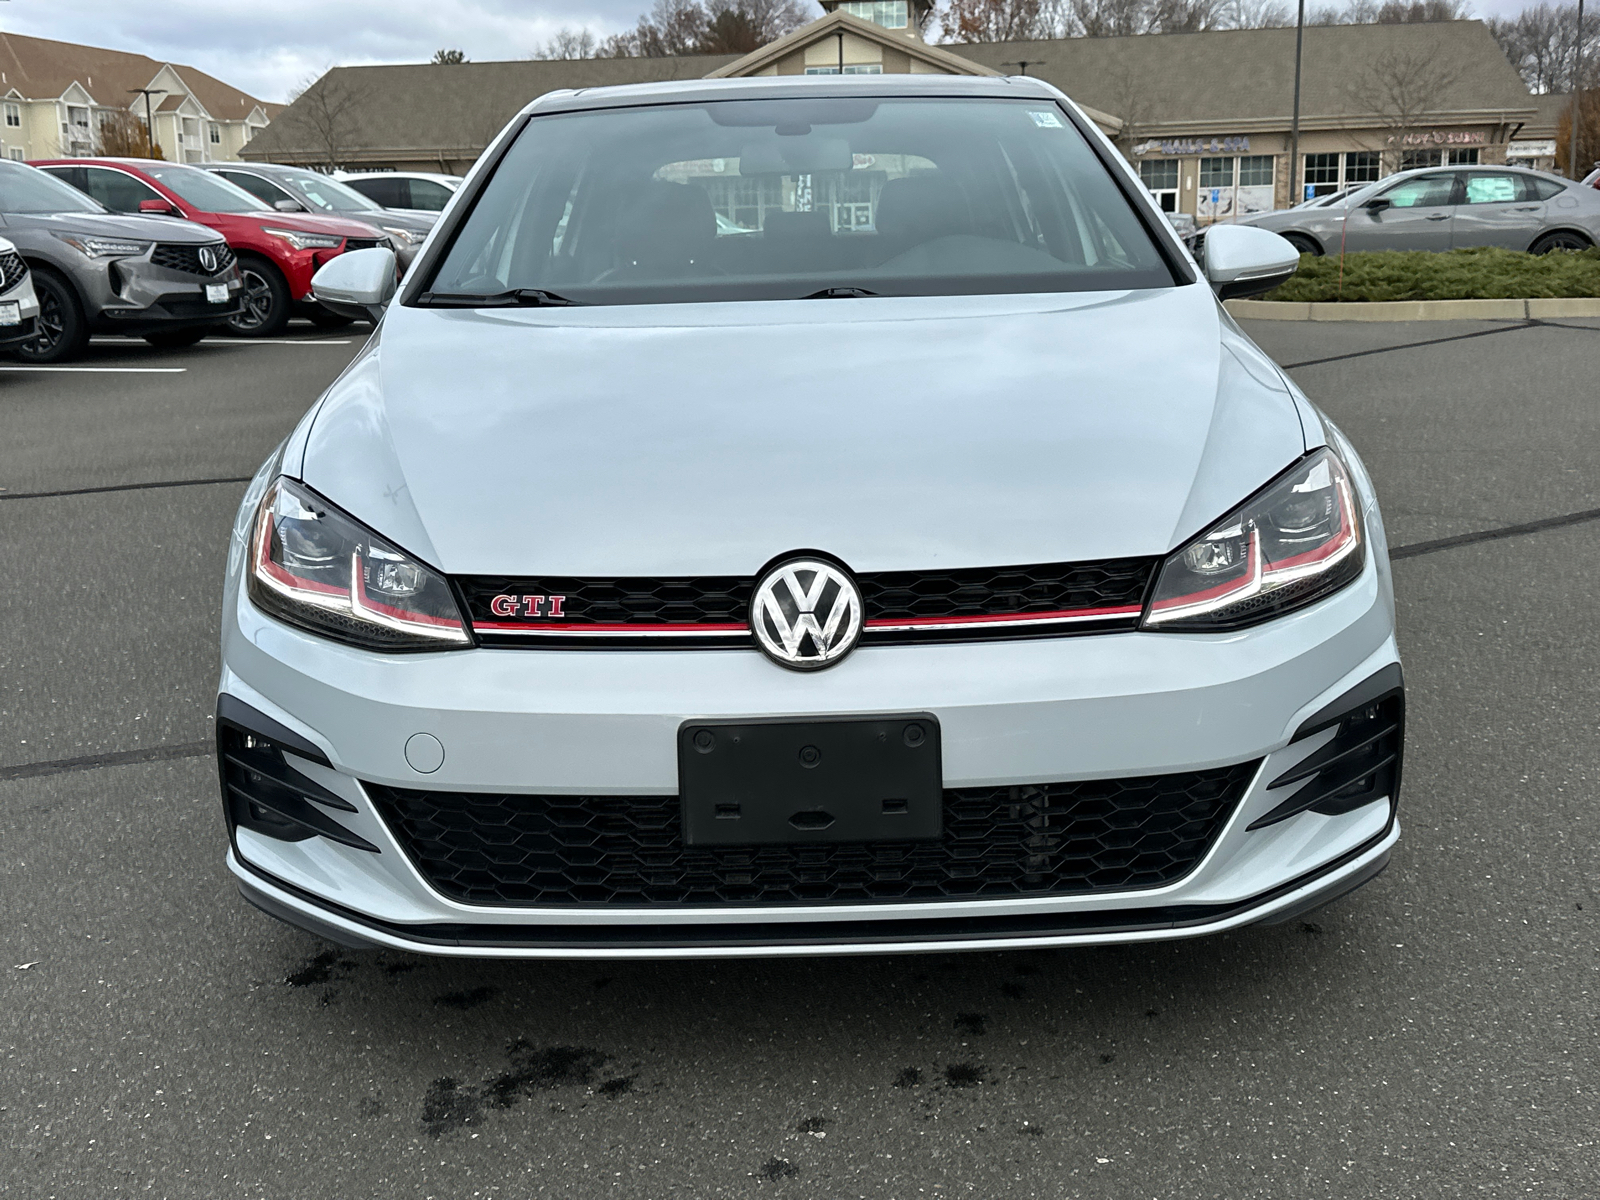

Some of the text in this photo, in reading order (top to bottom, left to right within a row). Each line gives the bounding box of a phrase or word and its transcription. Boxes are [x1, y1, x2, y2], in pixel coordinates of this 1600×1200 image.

[1161, 136, 1250, 154] NAILS & SPA
[490, 594, 566, 617] GTI
